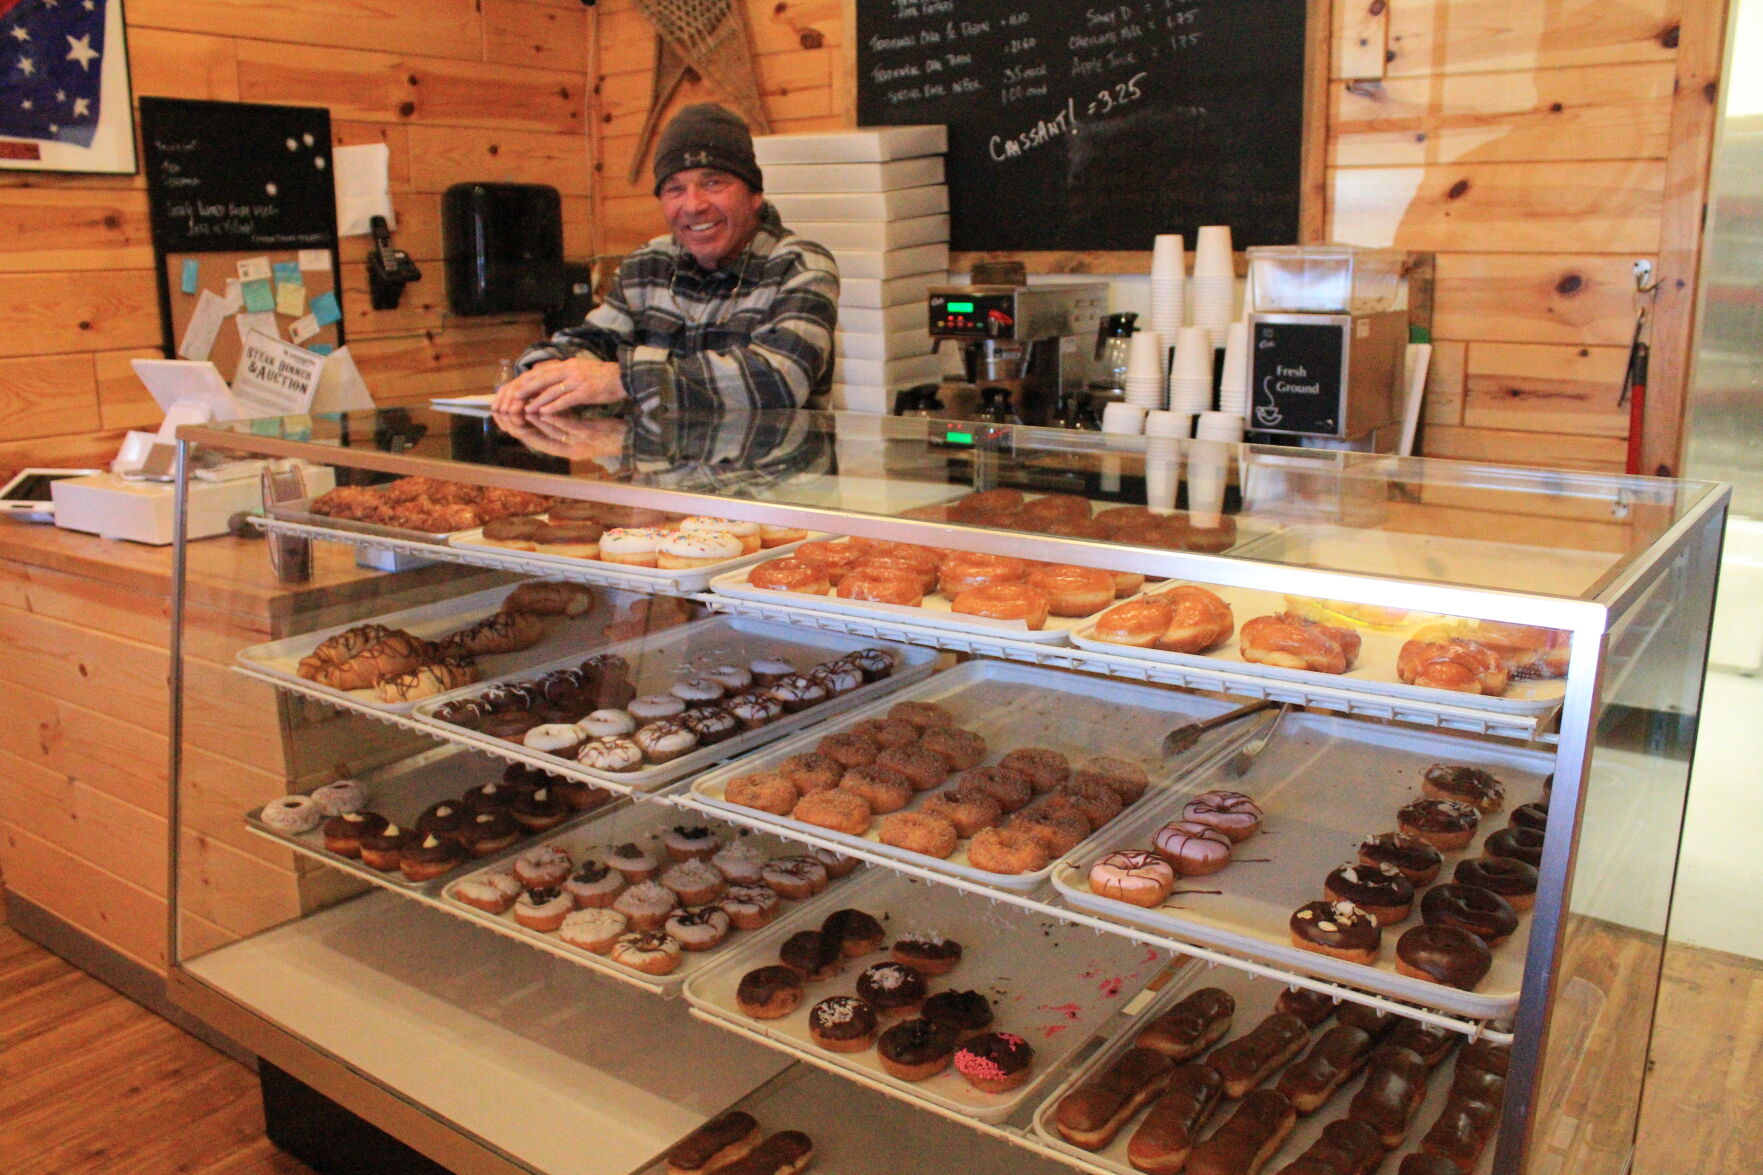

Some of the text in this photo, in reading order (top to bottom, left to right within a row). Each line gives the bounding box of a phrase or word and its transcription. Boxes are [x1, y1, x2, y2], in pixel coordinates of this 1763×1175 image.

[246, 346, 275, 366] STEAK
[278, 360, 312, 381] DINNER
[1276, 364, 1307, 378] Fresh
[1275, 381, 1320, 395] Ground
